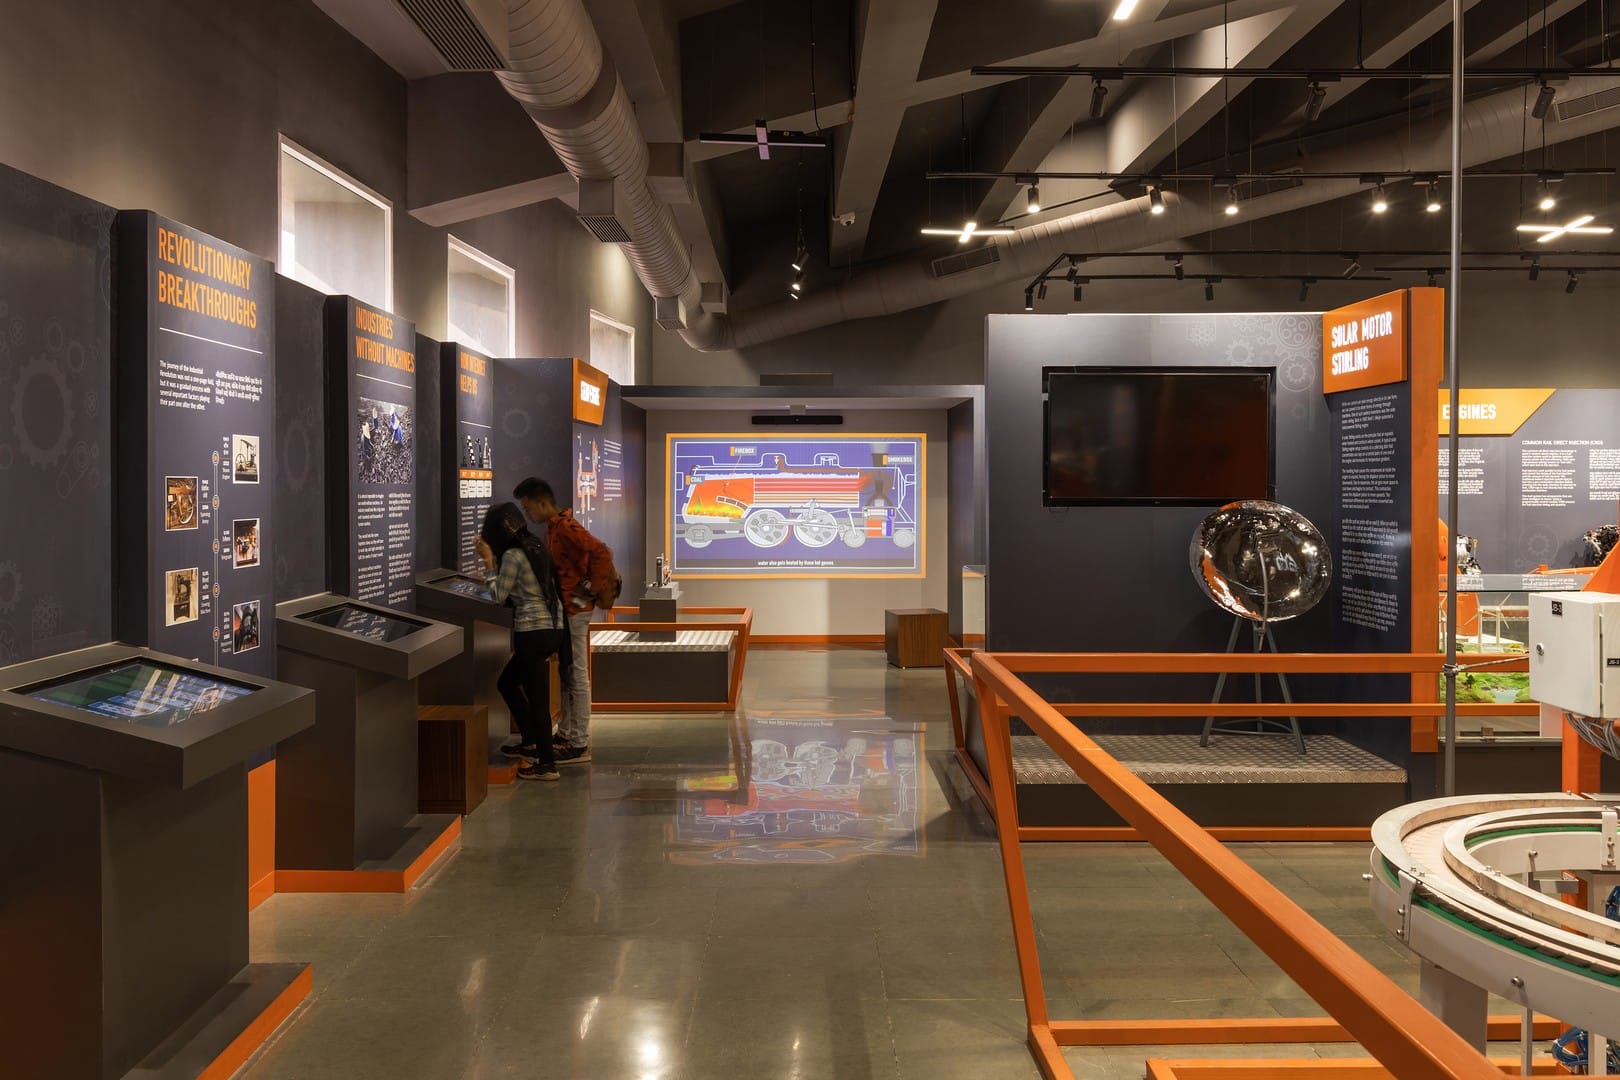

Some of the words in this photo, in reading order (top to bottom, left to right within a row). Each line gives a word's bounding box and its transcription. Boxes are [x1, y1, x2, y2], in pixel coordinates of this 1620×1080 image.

[158, 227, 252, 290] REVOLUTIONARY
[158, 270, 257, 329] BREAKTHROUGHS
[355, 305, 394, 340] INDUSTRIES
[1332, 320, 1359, 349] SOLAR
[1361, 311, 1393, 342] MOTOR
[167, 361, 178, 371] journey
[355, 335, 385, 365] WITHOUT
[385, 344, 415, 374] MACHINES
[1332, 346, 1369, 376] STIRLING
[1442, 404, 1497, 420] EGINES
